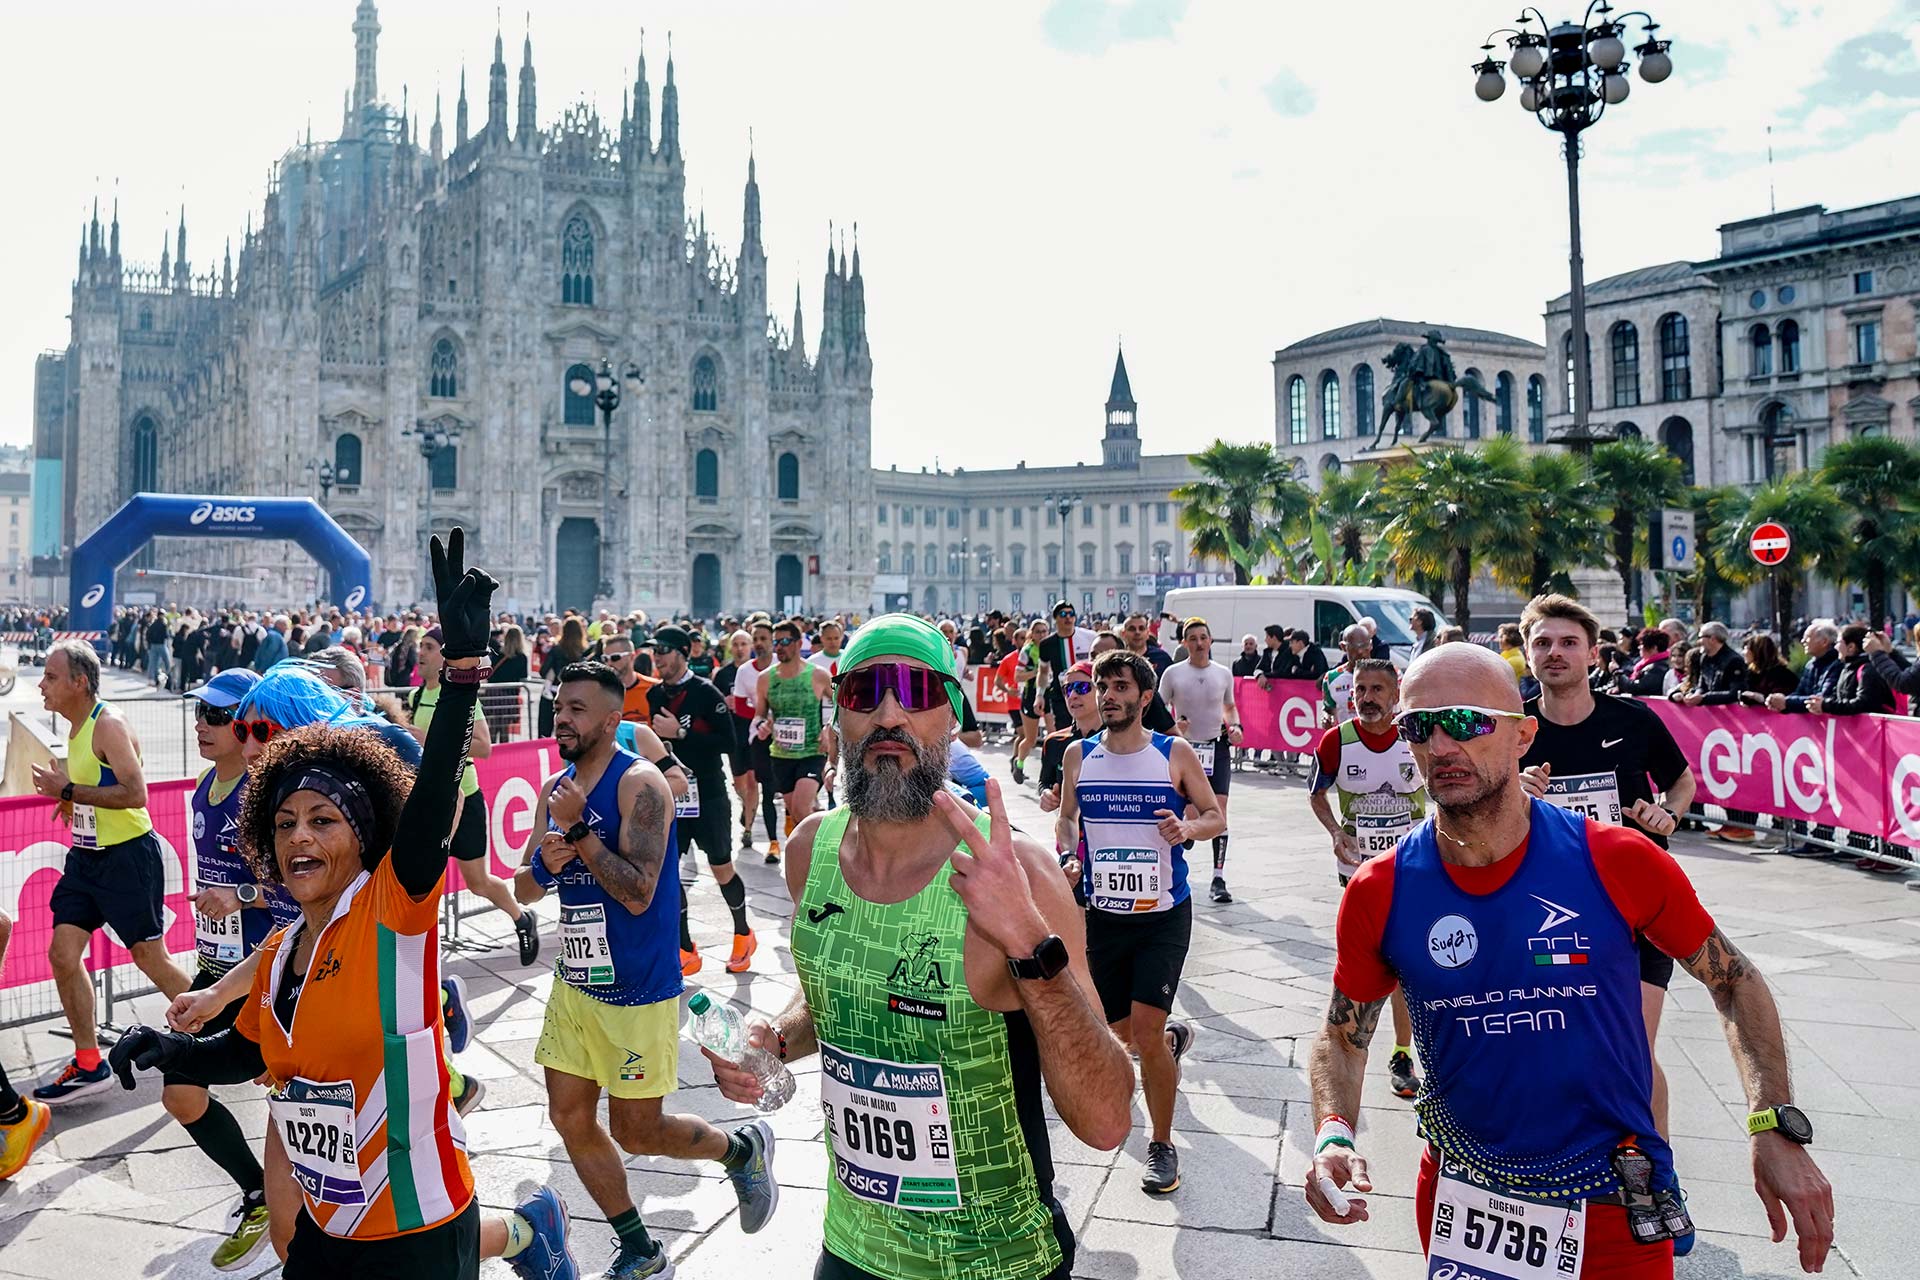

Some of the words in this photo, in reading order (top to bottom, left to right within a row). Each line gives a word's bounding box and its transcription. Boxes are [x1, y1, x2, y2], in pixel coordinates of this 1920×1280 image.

[212, 506, 256, 522] asics
[1702, 718, 1842, 818] enel
[1545, 781, 1567, 793] nel
[1082, 794, 1101, 802] ROAD
[1103, 794, 1143, 802] RUNNERS
[1145, 795, 1167, 803] CLUB
[1108, 804, 1141, 812] MILANO
[1095, 850, 1118, 860] enel
[1108, 873, 1143, 892] 5701
[1108, 900, 1130, 909] asics
[565, 936, 594, 960] 3172
[1528, 932, 1591, 950] nrt
[1423, 991, 1504, 1011] NAVIGLIO
[1509, 985, 1597, 1001] RUNNING
[899, 1001, 916, 1013] Ciao
[916, 1005, 942, 1017] Mauro
[1455, 1009, 1566, 1037] TEAM
[823, 1054, 855, 1083] enel
[891, 1073, 938, 1086] MILANO
[891, 1082, 939, 1091] MARATHON
[317, 1087, 352, 1099] MILANO
[850, 1092, 869, 1107] LUIGI
[870, 1097, 897, 1113] MIRKO
[932, 1104, 938, 1115] S
[299, 1107, 317, 1117] SUSY
[285, 1119, 339, 1163] 4228
[843, 1107, 917, 1161] 6169
[849, 1171, 889, 1196] asics
[1489, 1198, 1525, 1217] EUGENIO
[1463, 1207, 1549, 1268] 5736
